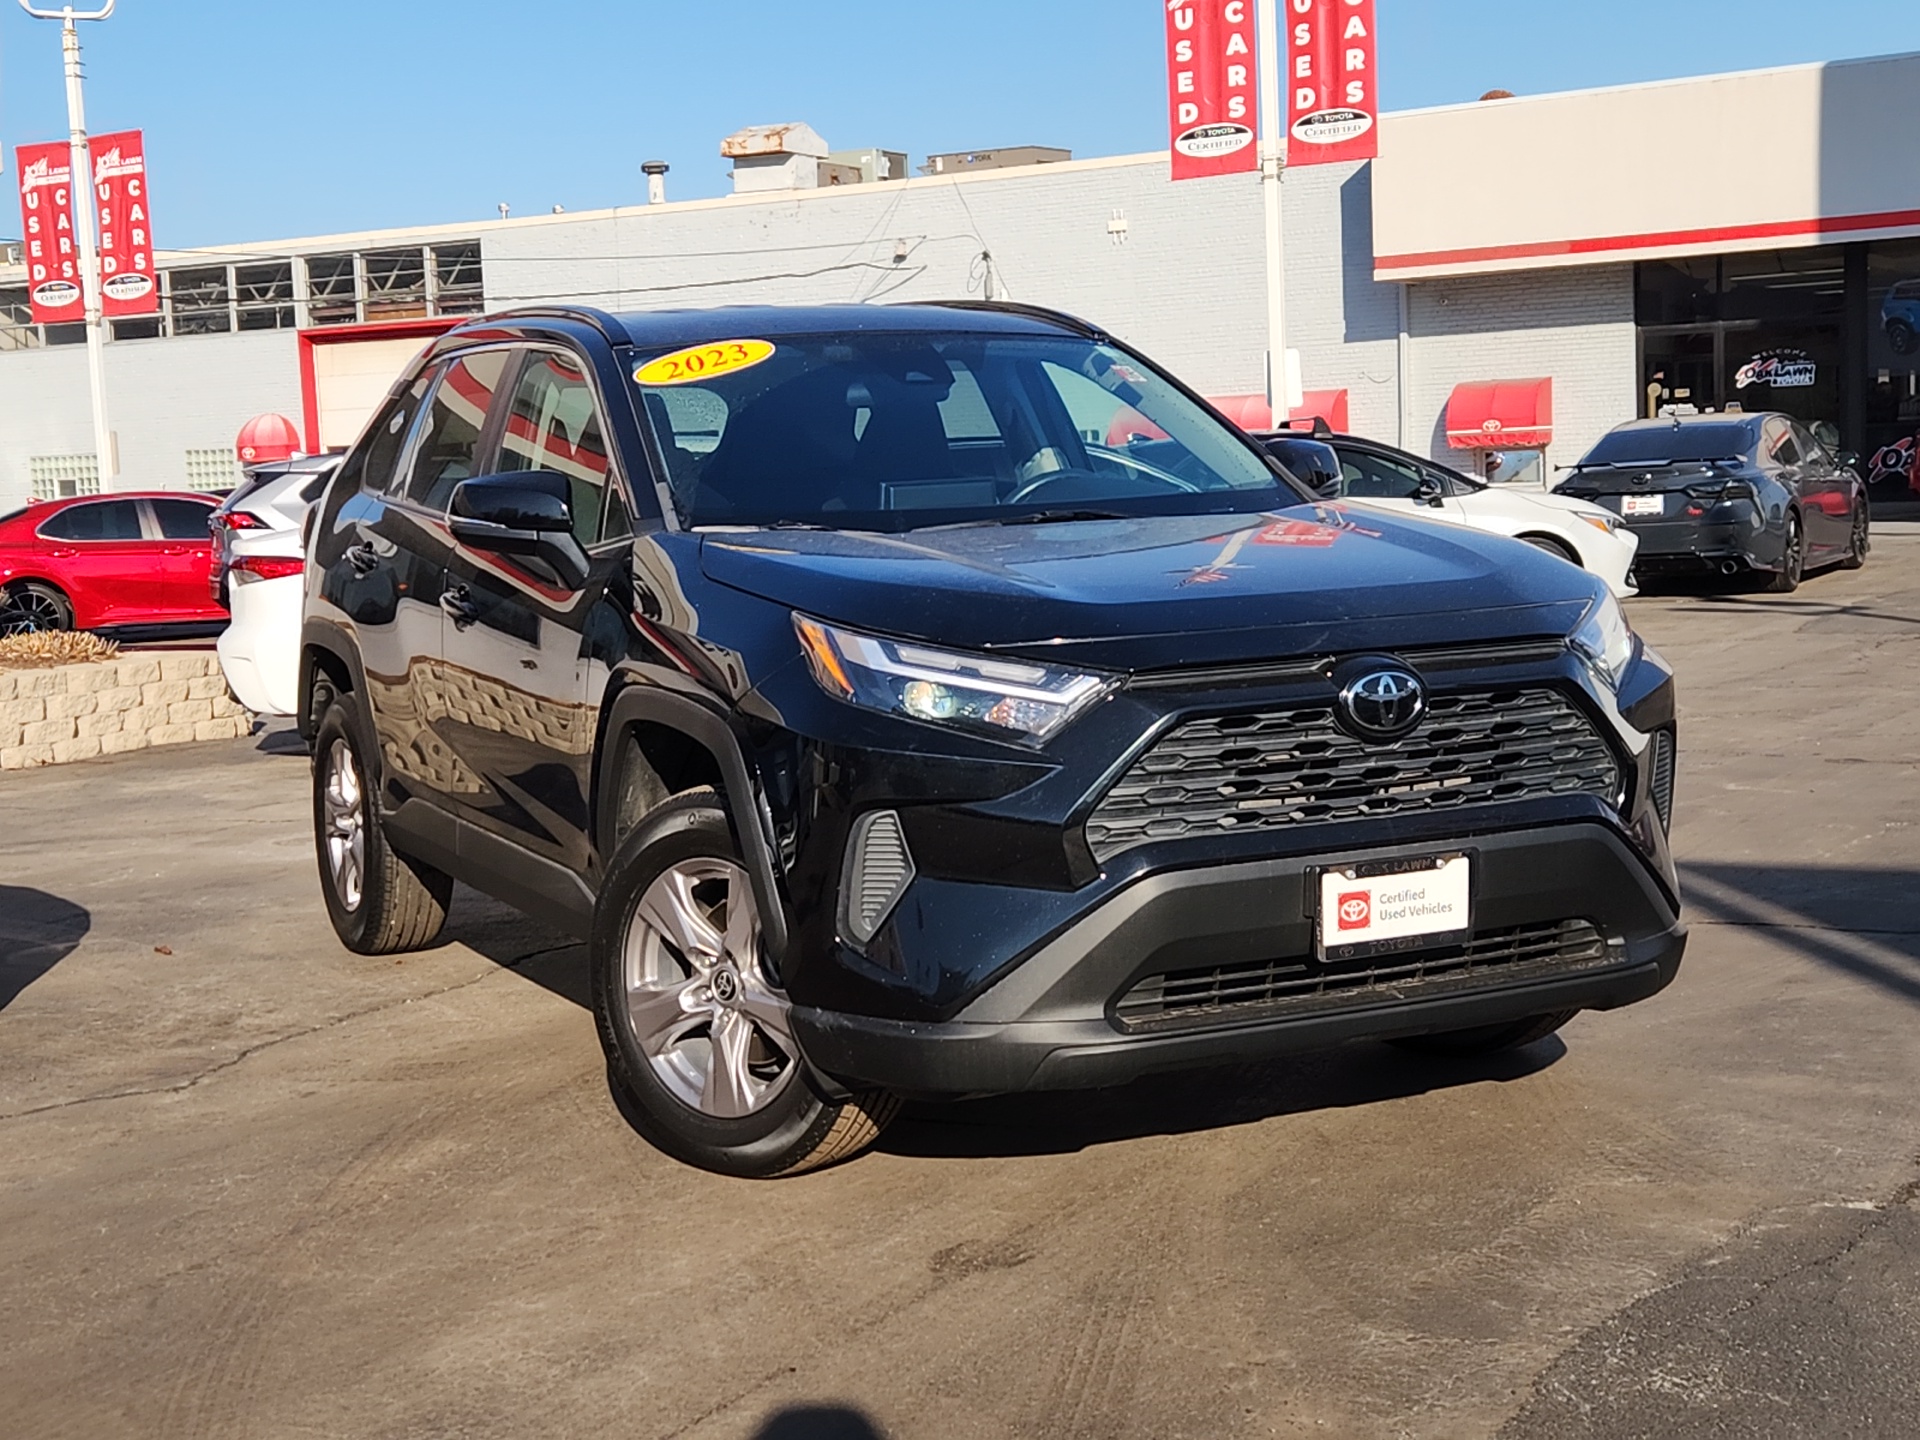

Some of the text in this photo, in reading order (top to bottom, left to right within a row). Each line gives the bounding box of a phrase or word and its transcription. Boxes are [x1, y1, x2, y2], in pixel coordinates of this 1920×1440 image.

[1224, 1, 1249, 119] CARS
[1343, 0, 1367, 104] ARS
[1174, 8, 1199, 125] USED
[1324, 112, 1355, 122] TOYOTA
[1207, 127, 1237, 137] TOYOTA
[1303, 124, 1362, 138] CERTIFIED
[1187, 138, 1243, 151] CERTIFIED
[55, 188, 74, 278] CARS
[98, 183, 118, 273] USED
[128, 178, 146, 270] CARS
[26, 192, 47, 281] USED
[662, 344, 748, 379] 2023
[1751, 347, 1808, 360] WELCOME
[1361, 857, 1432, 875] OK LAWN
[1379, 887, 1426, 905] Certified
[1379, 902, 1453, 921] Used Vehicles
[1369, 936, 1424, 954] TOYOTA
